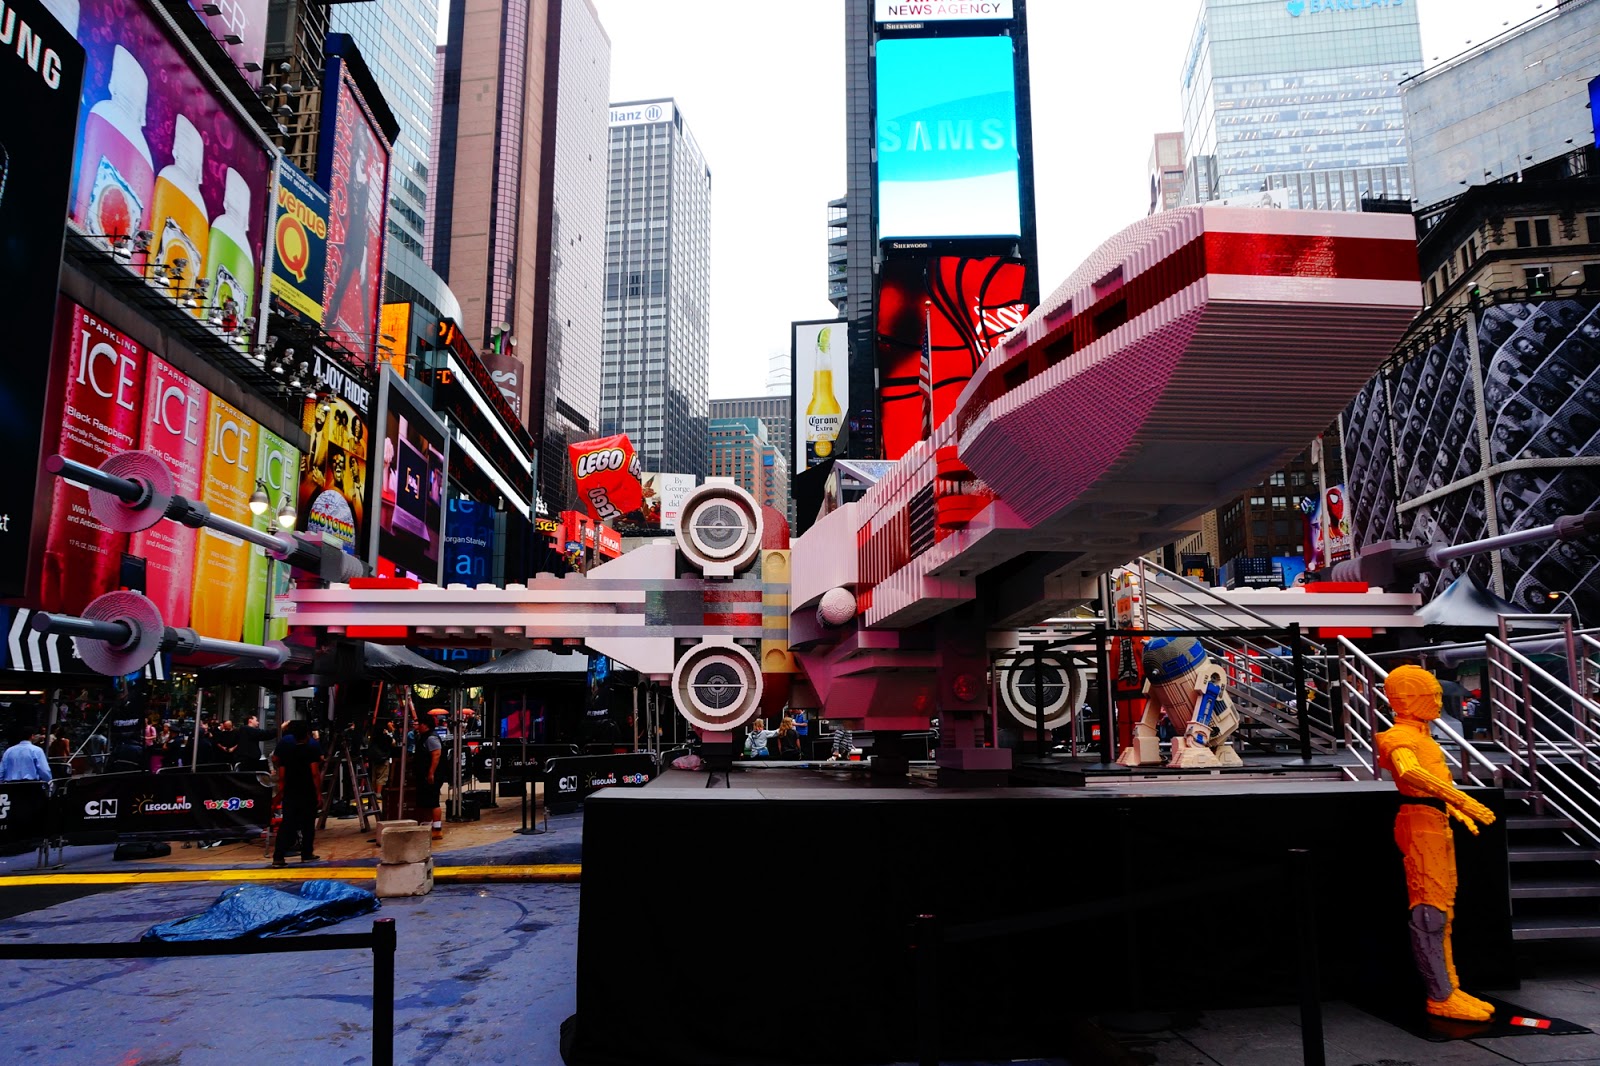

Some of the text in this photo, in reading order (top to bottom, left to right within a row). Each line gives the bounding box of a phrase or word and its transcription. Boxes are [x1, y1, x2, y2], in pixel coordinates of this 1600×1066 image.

[889, 3, 1001, 15] NEWS AGENCY
[0, 0, 61, 89] UNG
[610, 110, 641, 122] lianz
[277, 183, 326, 239] venue
[276, 213, 309, 283] Q
[83, 314, 137, 354] SPARKLING
[76, 329, 137, 411] ICE
[157, 362, 200, 395] SPARKLING
[322, 363, 344, 394] JOY
[153, 375, 200, 446] ICE
[216, 401, 251, 426] SPARKLING
[809, 416, 839, 427] Corona
[67, 405, 134, 446] Black Raspberry
[212, 412, 250, 472] ICE
[148, 444, 196, 474] Pink Grapefruit
[260, 443, 293, 495] ICE
[578, 449, 624, 478] LEGO
[674, 477, 683, 485] By
[67, 515, 79, 524] and
[72, 504, 87, 515] With
[308, 509, 353, 538] MOTOWN
[465, 536, 487, 547] Stanley
[559, 775, 577, 789] CN
[592, 776, 617, 786] LEGOLAND
[84, 799, 118, 815] CN
[145, 800, 192, 811] LEGOLAND
